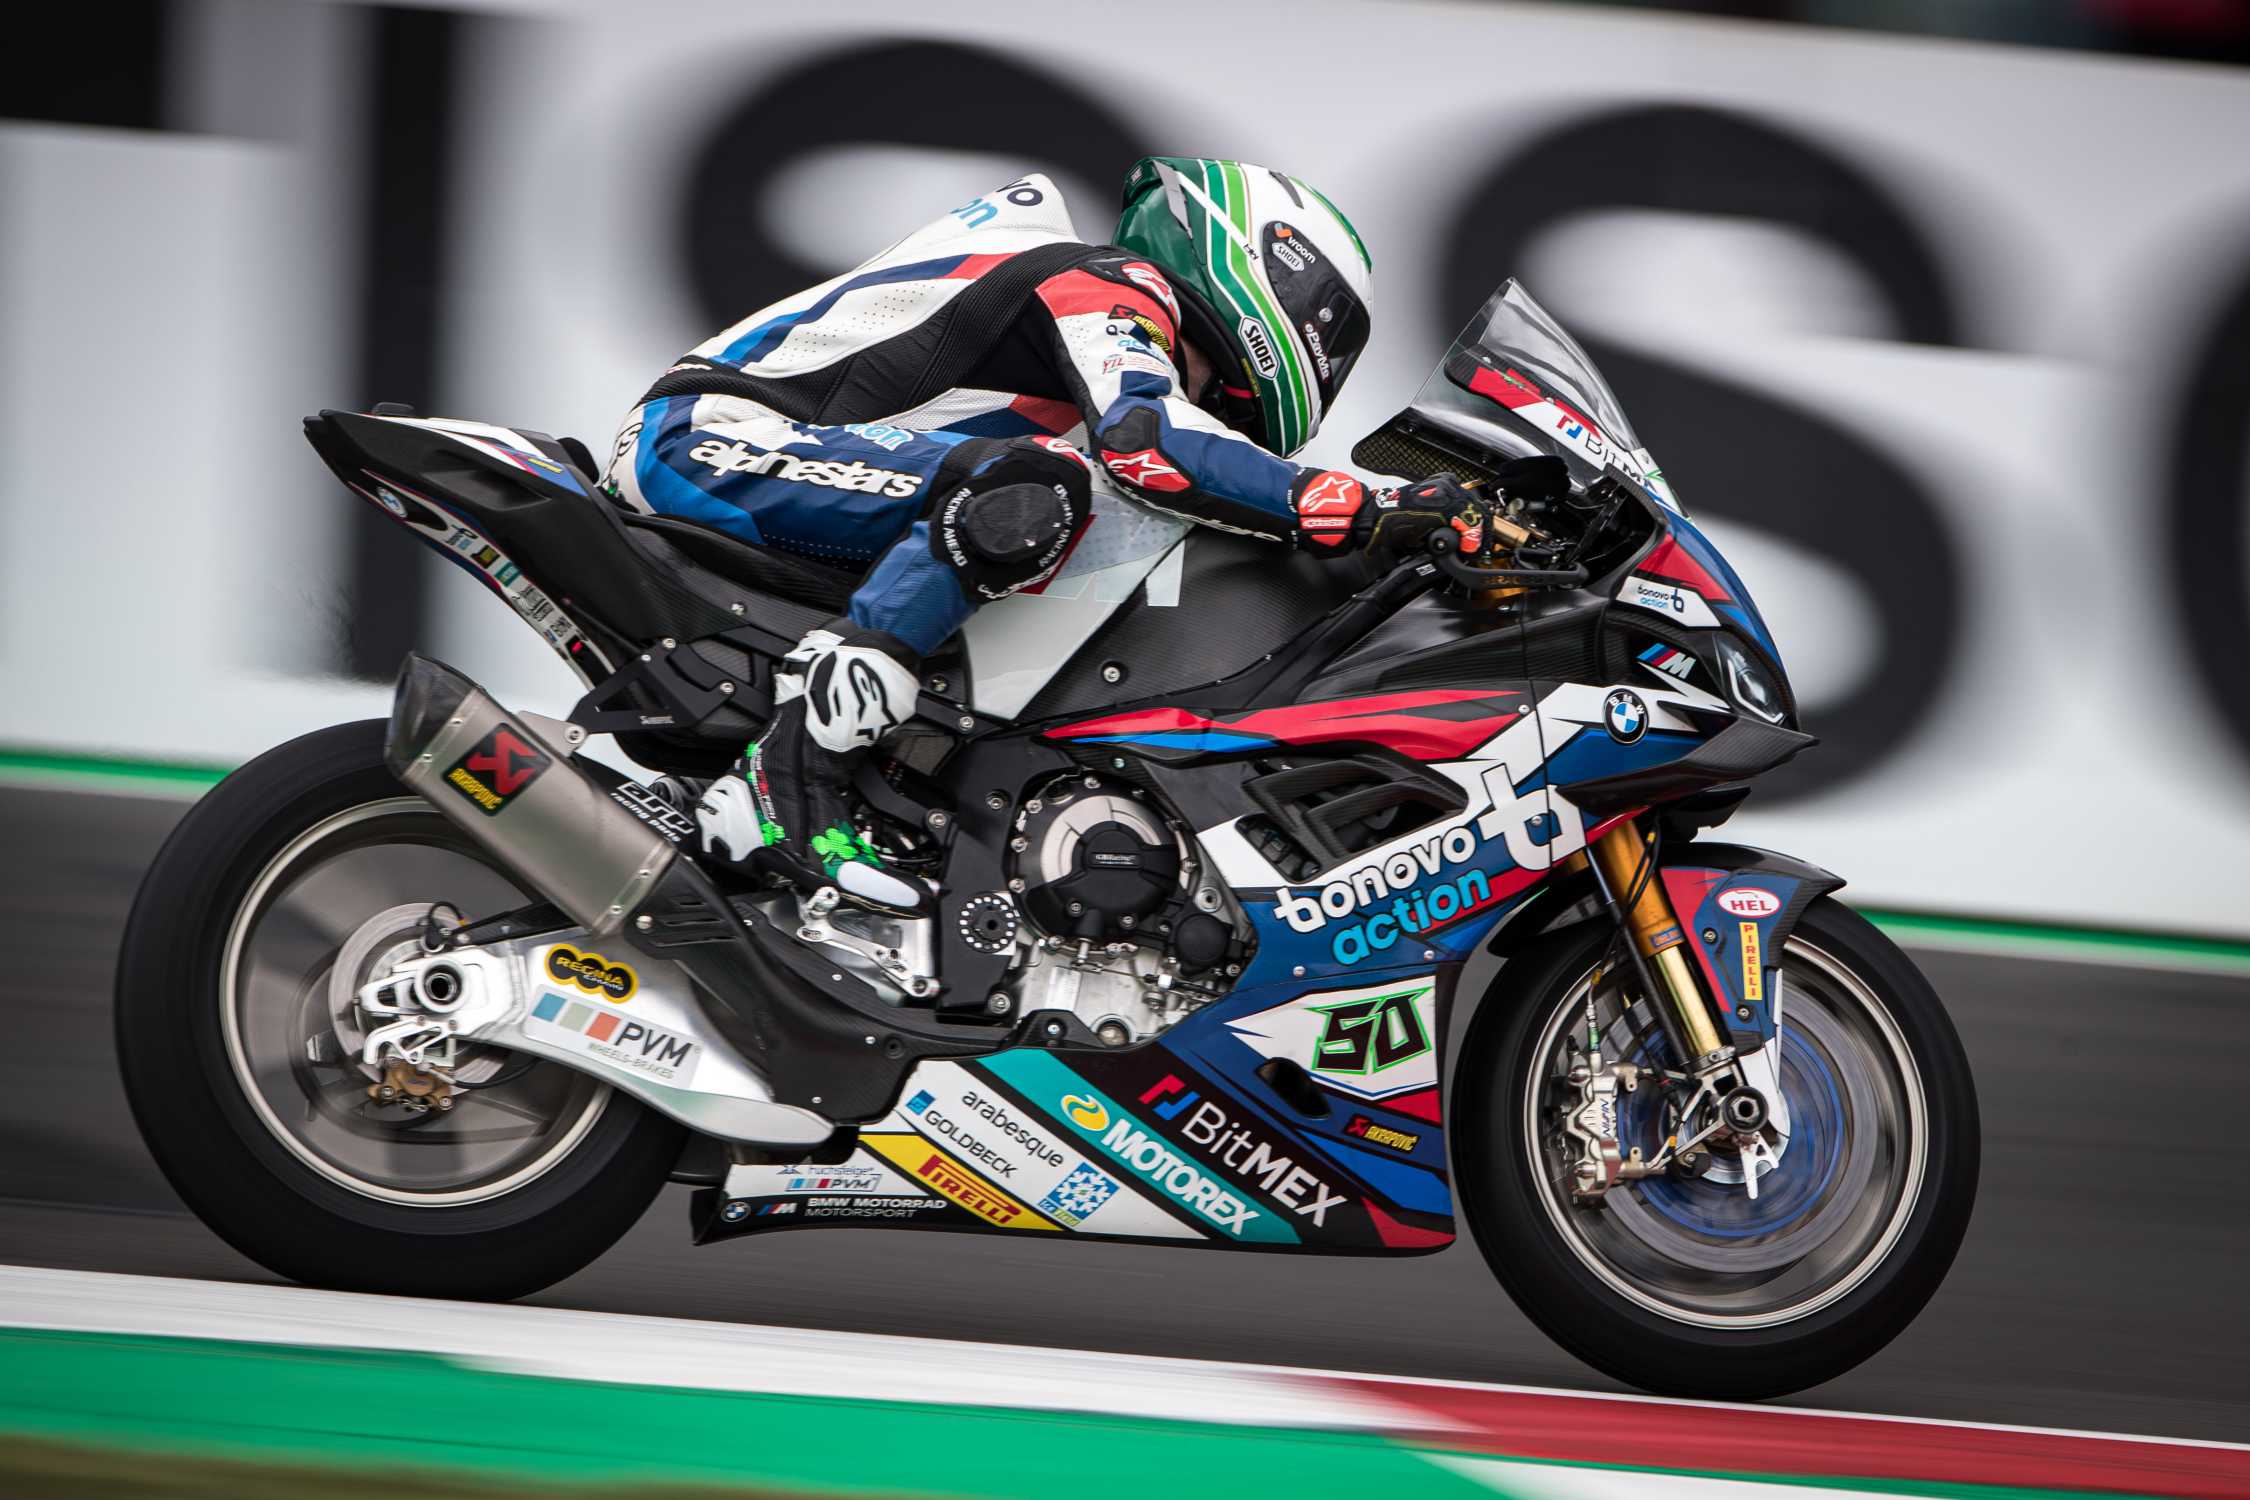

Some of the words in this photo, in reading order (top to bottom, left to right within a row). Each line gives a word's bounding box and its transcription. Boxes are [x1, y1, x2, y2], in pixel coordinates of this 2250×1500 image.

[1288, 236, 1316, 264] vroom
[1244, 325, 1275, 373] SHOEI
[943, 527, 969, 567] AHEAD
[1637, 586, 1670, 600] bonovo
[610, 792, 650, 821] racing
[1273, 825, 1477, 934] bonovo
[1331, 867, 1493, 966] action
[1729, 899, 1773, 912] HEL
[1743, 924, 1758, 997] PIRELLI
[613, 1021, 694, 1068] PVM
[1304, 986, 1436, 1075] 50
[924, 1109, 1019, 1179] GOLDBECK
[961, 1090, 1065, 1169] arabesque
[830, 1178, 871, 1189] PVM
[1101, 1118, 1260, 1236] MOTOREX
[1181, 1101, 1348, 1228] BitMEX
[804, 1208, 918, 1219] MOTORSPORT
[806, 1197, 850, 1209] BMW
[852, 1198, 948, 1210] MOTORRAD
[917, 1154, 1022, 1225] PIRELLI
